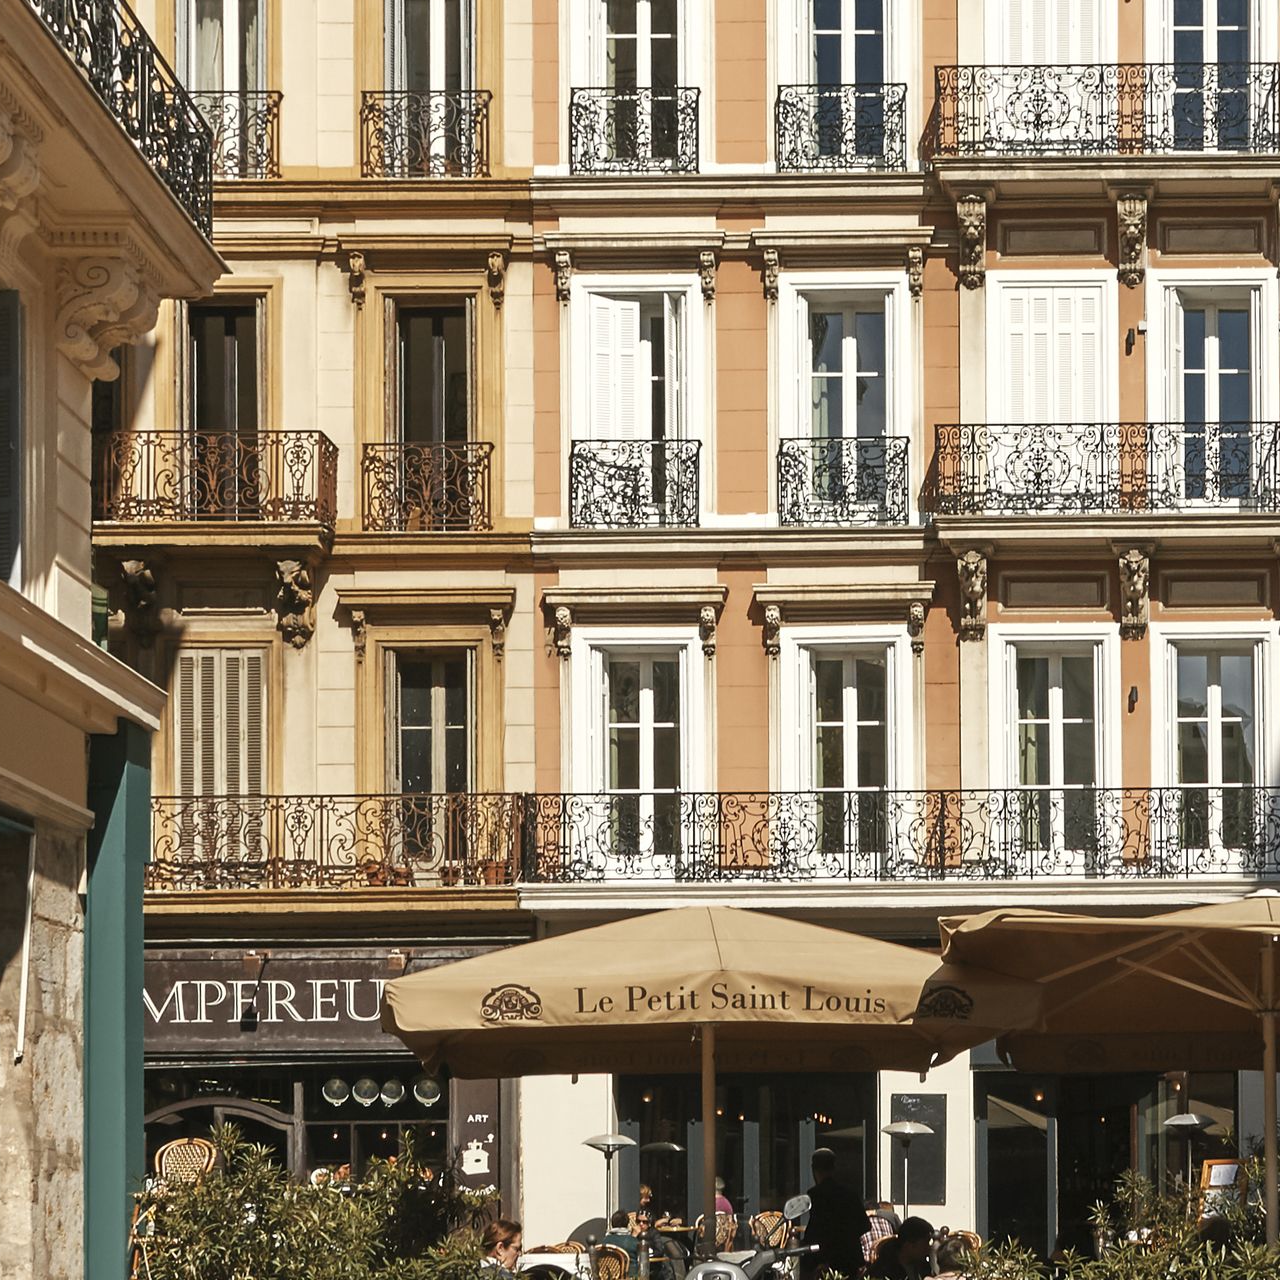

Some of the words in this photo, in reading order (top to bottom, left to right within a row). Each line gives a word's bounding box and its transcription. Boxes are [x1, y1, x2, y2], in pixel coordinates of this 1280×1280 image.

[573, 986, 614, 1014] Le
[624, 985, 700, 1012] Petit
[711, 982, 791, 1011] Saint
[802, 985, 887, 1014] Louis
[467, 1114, 489, 1123] ART
